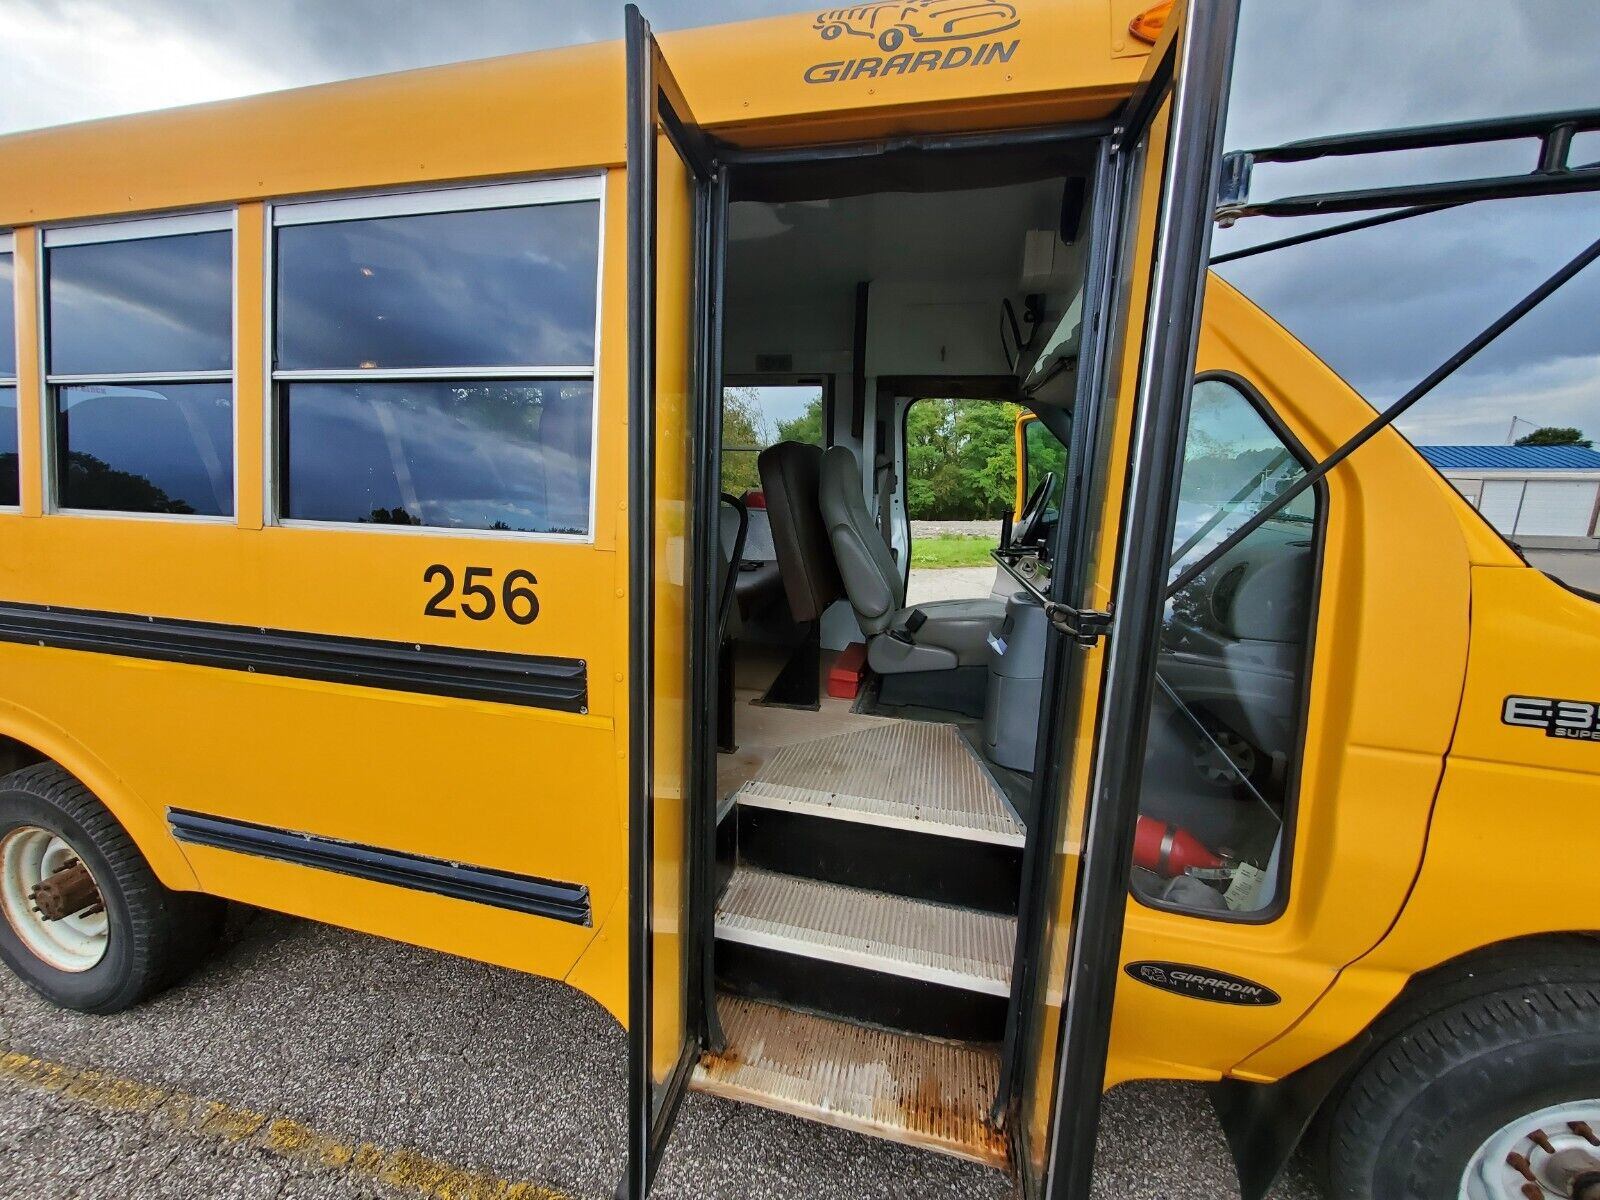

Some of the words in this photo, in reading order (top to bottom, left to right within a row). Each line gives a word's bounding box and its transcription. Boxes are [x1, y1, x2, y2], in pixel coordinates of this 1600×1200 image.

[803, 39, 1021, 84] GIRARDIN
[423, 564, 540, 625] 256
[1504, 697, 1600, 730] E-3
[1170, 971, 1262, 996] GIRARDIN
